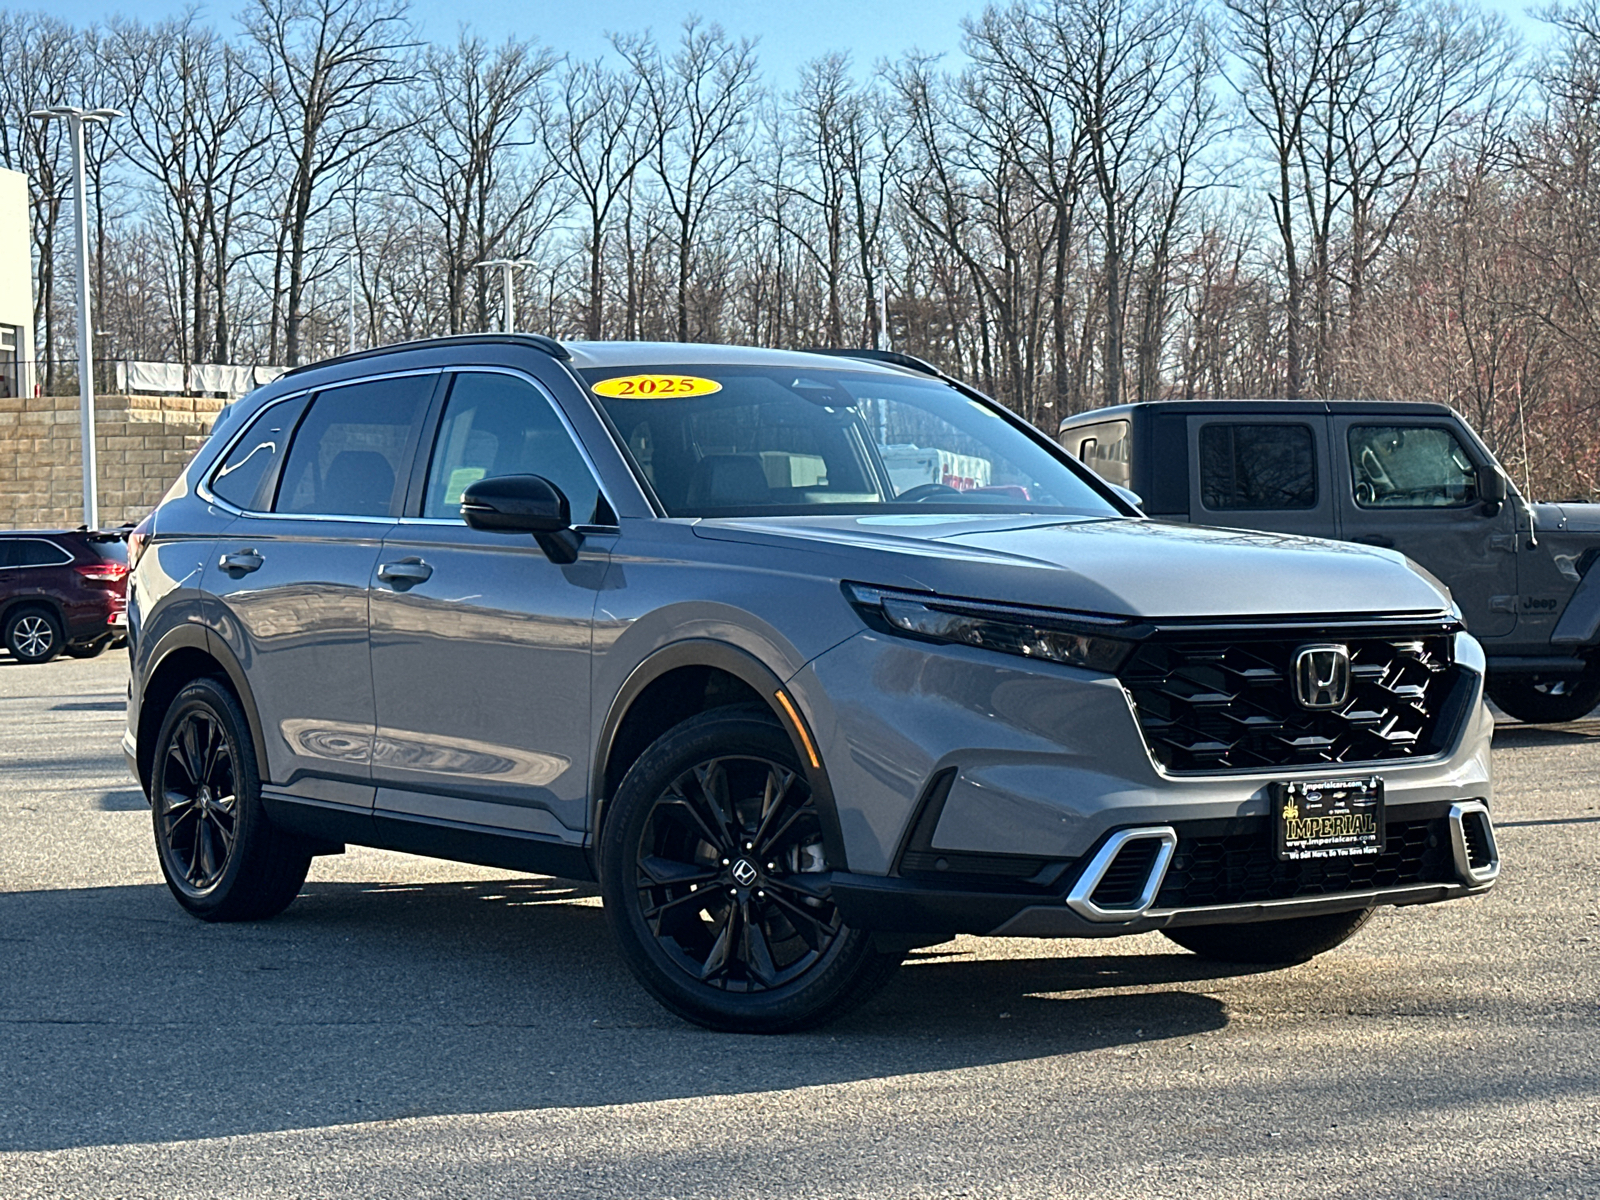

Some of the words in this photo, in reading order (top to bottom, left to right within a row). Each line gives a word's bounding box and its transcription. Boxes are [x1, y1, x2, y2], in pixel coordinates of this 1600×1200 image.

[618, 379, 695, 396] 2025
[1523, 596, 1557, 610] Jeep
[1286, 814, 1377, 840] IMPERIAL
[1286, 834, 1376, 847] www.imperialcars.com
